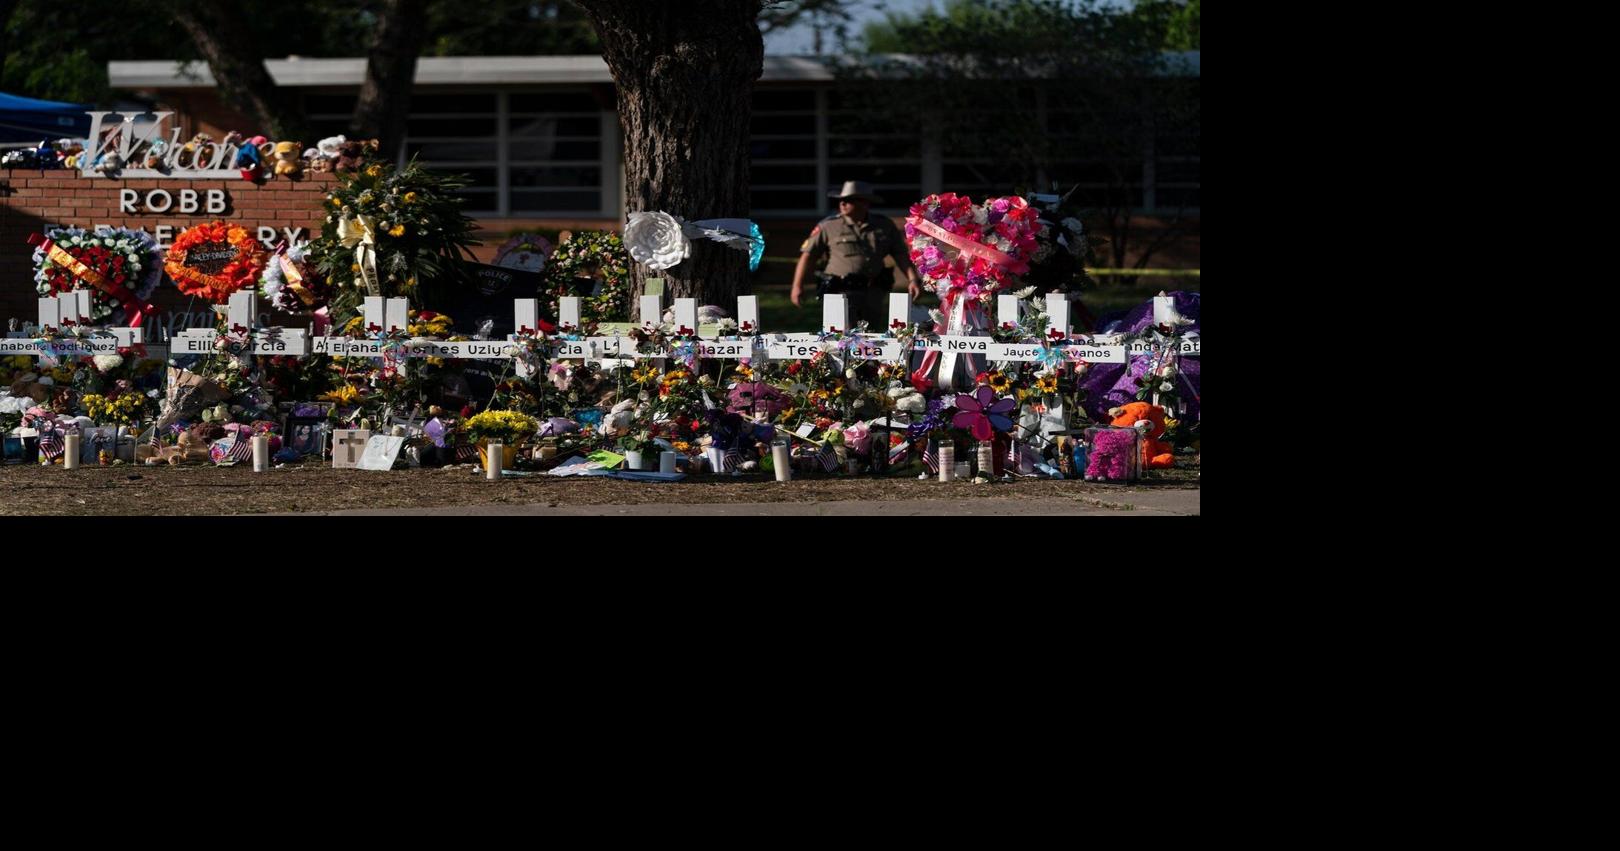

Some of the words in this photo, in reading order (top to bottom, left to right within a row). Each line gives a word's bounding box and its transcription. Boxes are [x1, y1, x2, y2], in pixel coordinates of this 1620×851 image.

[119, 189, 228, 214] ROBB
[402, 344, 459, 354] orres
[468, 344, 511, 356] Uziy
[547, 344, 583, 354] rcia
[697, 344, 743, 355] lazar
[787, 345, 819, 356] Tes
[844, 344, 883, 355] ata
[1003, 347, 1039, 358] Jayce
[1063, 349, 1111, 358] evanos
